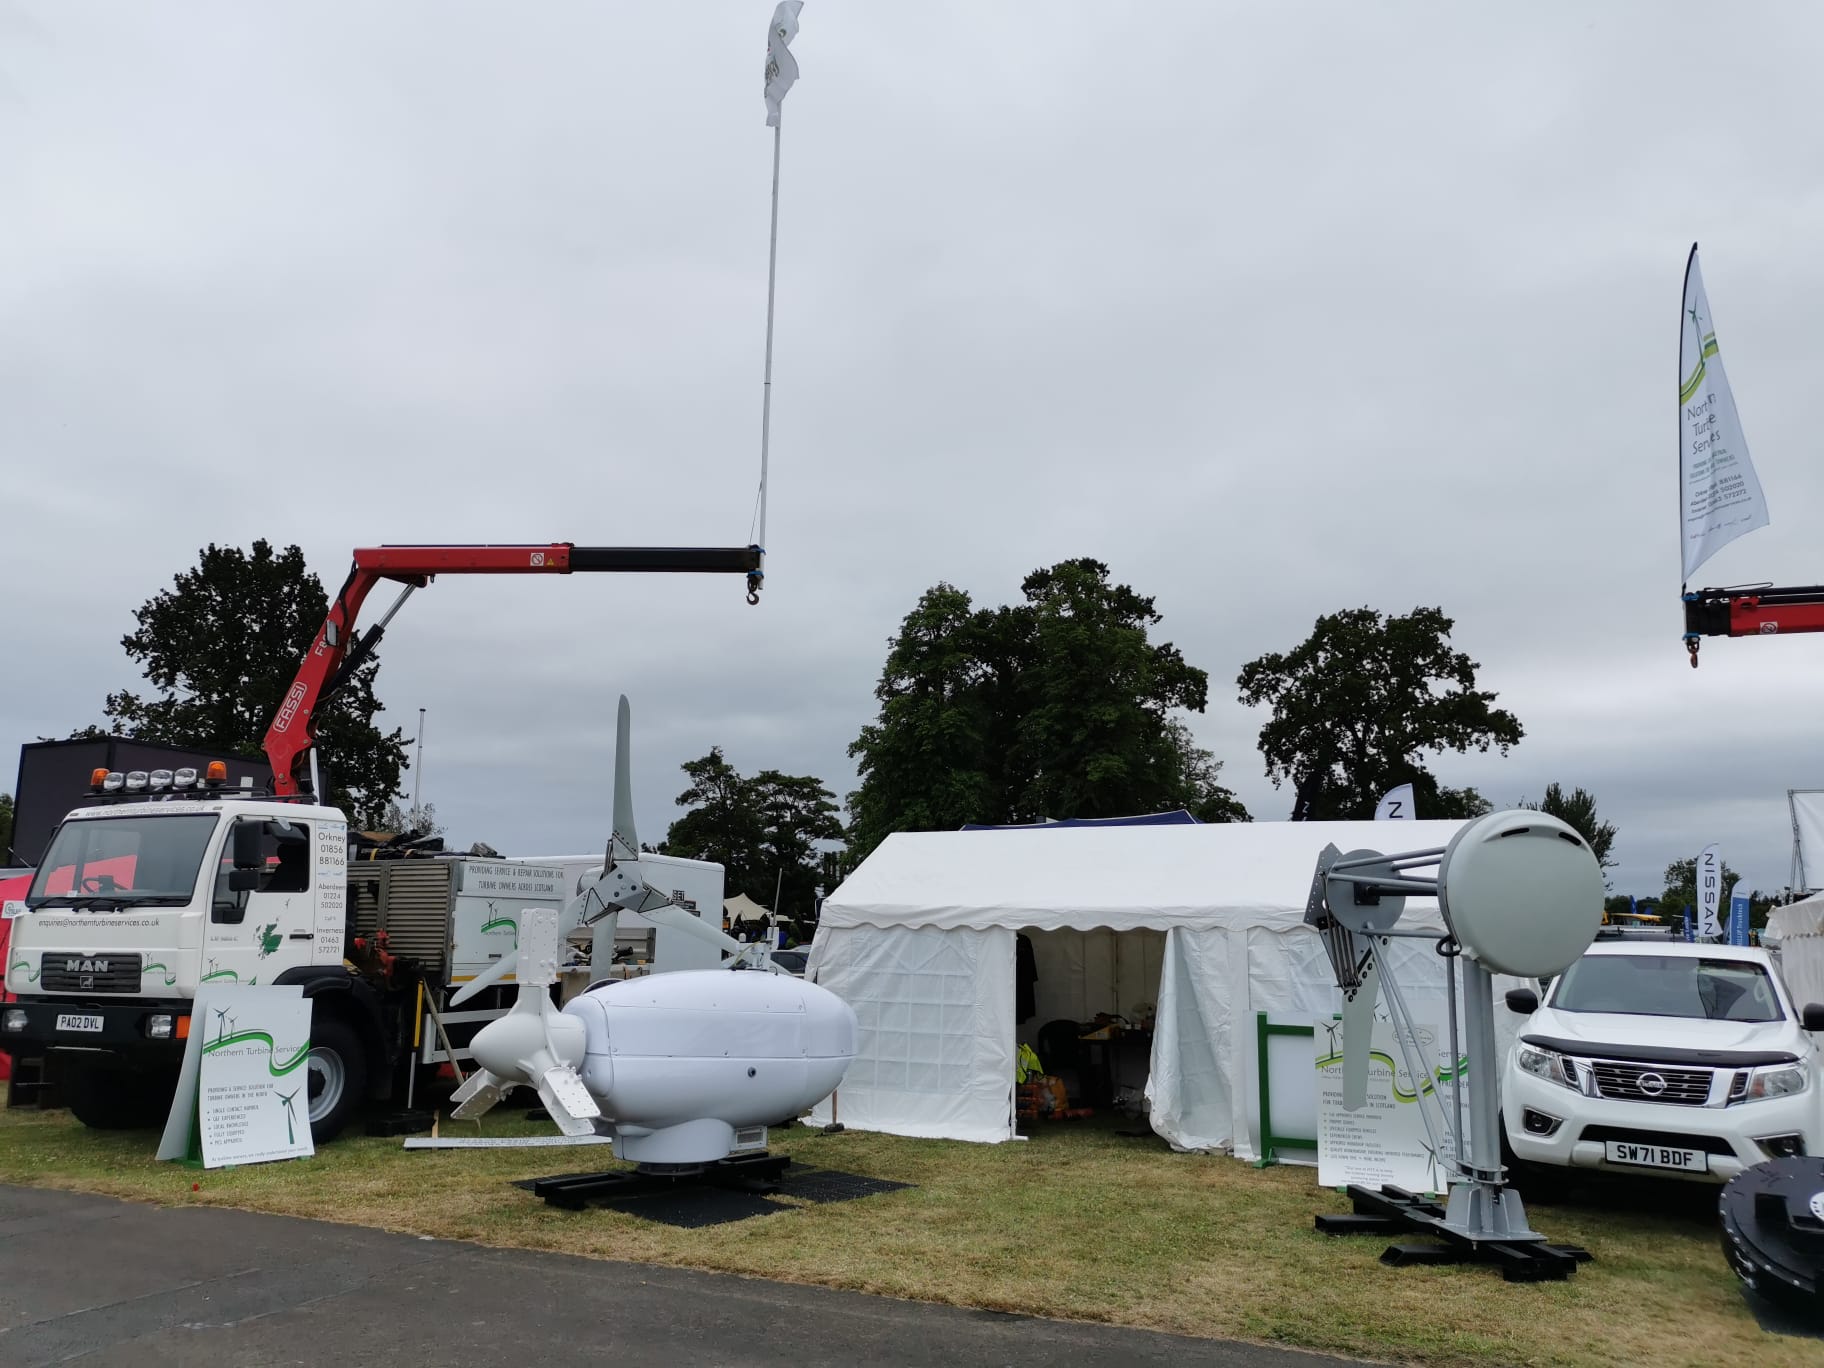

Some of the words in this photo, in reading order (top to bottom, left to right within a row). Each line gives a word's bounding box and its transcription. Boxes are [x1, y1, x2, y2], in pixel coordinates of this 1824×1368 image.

[276, 683, 304, 729] FASSI
[318, 832, 346, 844] Orkney
[320, 844, 344, 854] 01856
[1704, 853, 1716, 935] NISSAN
[66, 959, 109, 973] MAN
[60, 1015, 82, 1029] PA02
[83, 1017, 100, 1030] DVL
[208, 1048, 245, 1058] Northern
[1616, 1144, 1655, 1163] SW71
[1659, 1149, 1694, 1166] BDF
